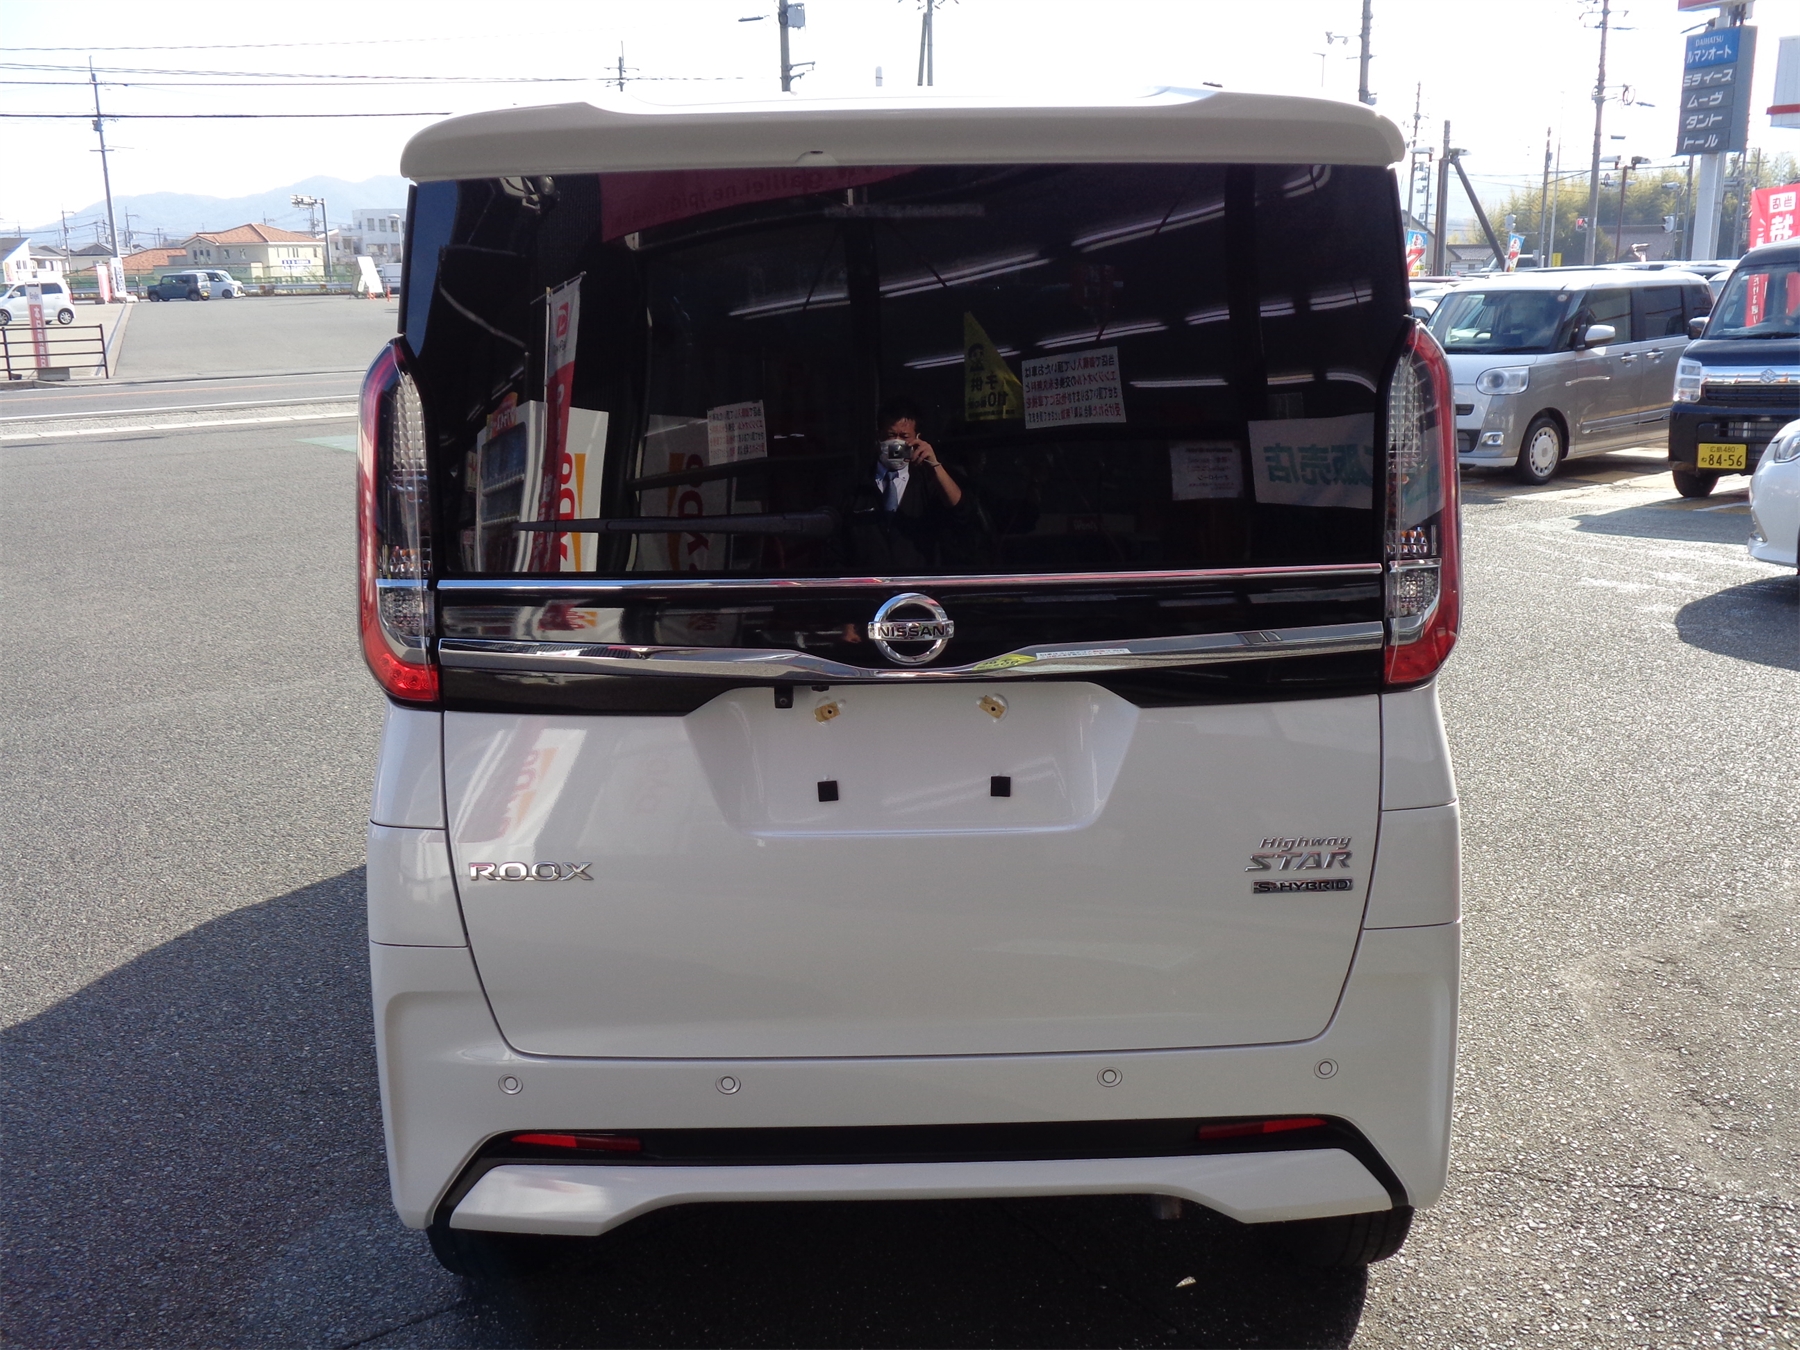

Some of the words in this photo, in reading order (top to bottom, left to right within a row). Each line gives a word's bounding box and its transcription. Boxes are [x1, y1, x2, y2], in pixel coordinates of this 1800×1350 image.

[1695, 35, 1724, 47] DAIHATSU
[1683, 69, 1733, 87] ミライース
[1687, 91, 1724, 108] ムーヴ
[1686, 113, 1722, 129] タント
[1683, 134, 1718, 150] トール
[1708, 454, 1743, 467] 84-56
[877, 625, 945, 637] NISSAN
[1259, 836, 1352, 853] Highway
[1244, 849, 1353, 872] STAR
[468, 862, 594, 881] ROOX
